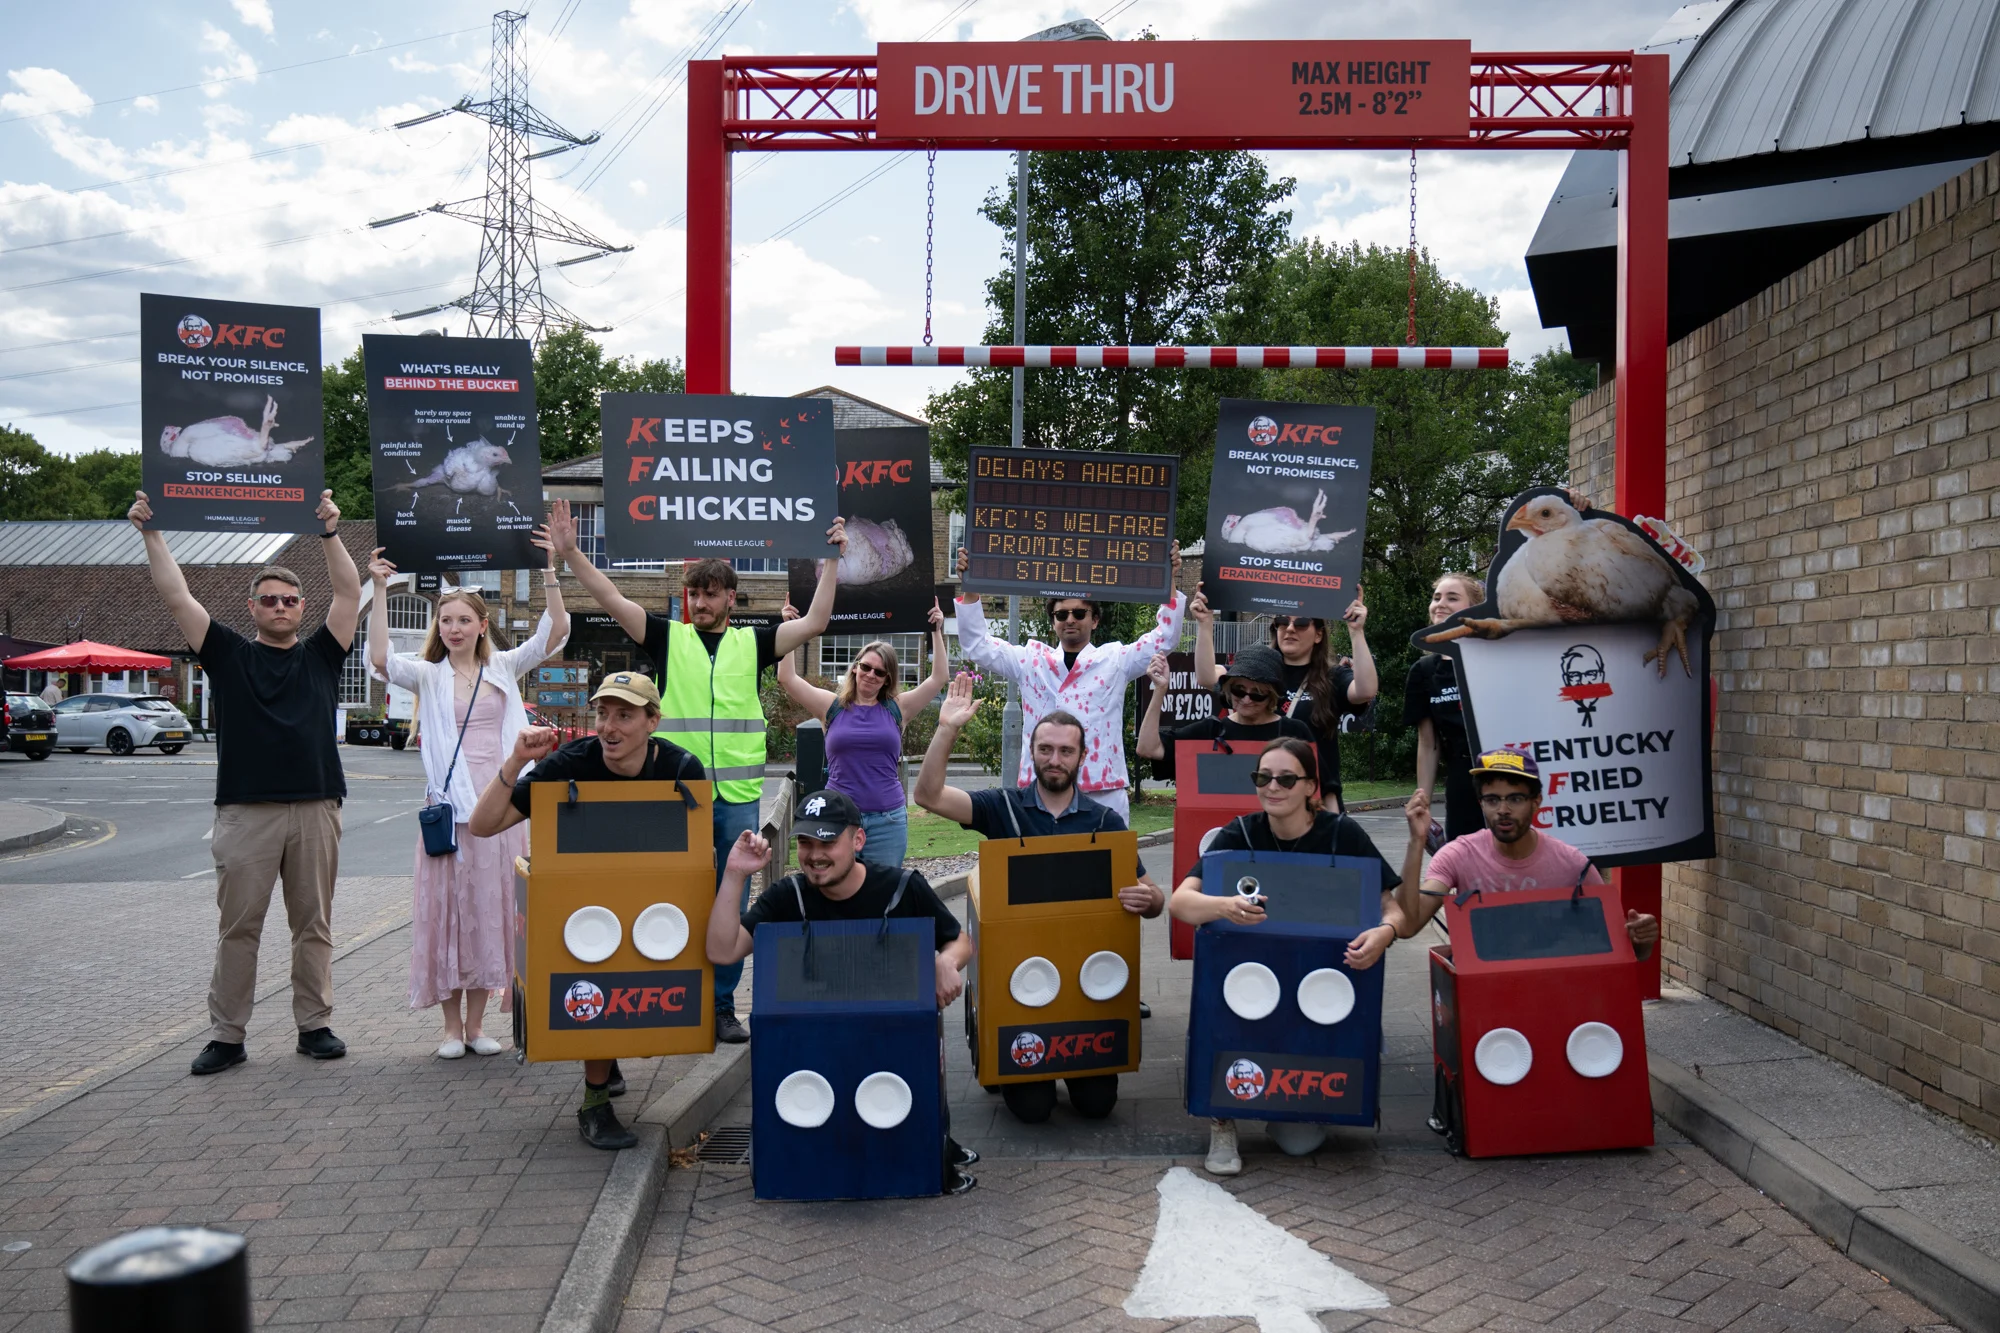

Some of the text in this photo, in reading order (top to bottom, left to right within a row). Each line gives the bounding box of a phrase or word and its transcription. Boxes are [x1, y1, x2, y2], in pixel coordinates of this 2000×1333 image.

[1291, 60, 1431, 85] MAX HEIGHT
[914, 62, 1175, 115] DRIVE THRU
[1299, 93, 1351, 115] 2.5M
[213, 323, 286, 350] KFC
[158, 353, 309, 374] BREAK YOUR SILENCE,
[454, 364, 500, 376] REALLY
[181, 369, 284, 385] NOT PROMISES
[385, 378, 517, 390] BEHIND THE BUCKET
[414, 409, 437, 417] barely
[626, 417, 754, 446] KEEPS
[1277, 423, 1343, 446] KFC
[381, 442, 407, 450] painful
[628, 456, 773, 483] FAILING
[977, 456, 1166, 486] DELAYS AHEAD!
[1228, 450, 1360, 470] BREAK YOUR SILENCE,
[186, 471, 282, 484] STOP SELLING
[842, 460, 913, 490] KFC
[1246, 464, 1336, 480] NOT PROMISES
[167, 485, 302, 499] FRANKENCHICKENS
[496, 516, 513, 524] lying
[628, 495, 815, 522] CHICKENS
[975, 507, 1167, 537] KFC'S WELFARE
[988, 533, 1150, 562] PROMISE HAS
[1016, 560, 1119, 585] STALLED
[1239, 556, 1323, 572] STOP SELLING
[1221, 568, 1339, 587] FRANKENCHICKENS
[859, 612, 885, 620] LEAGUE
[1169, 671, 1188, 690] HOT
[1441, 686, 1458, 695] SAY
[1161, 693, 1213, 721] OR £7.99
[1548, 766, 1643, 795] FRIED
[1532, 796, 1670, 829] CRUELTY
[604, 986, 687, 1020] KFC
[1045, 1031, 1116, 1062] KFC
[1264, 1068, 1349, 1102] KFC
